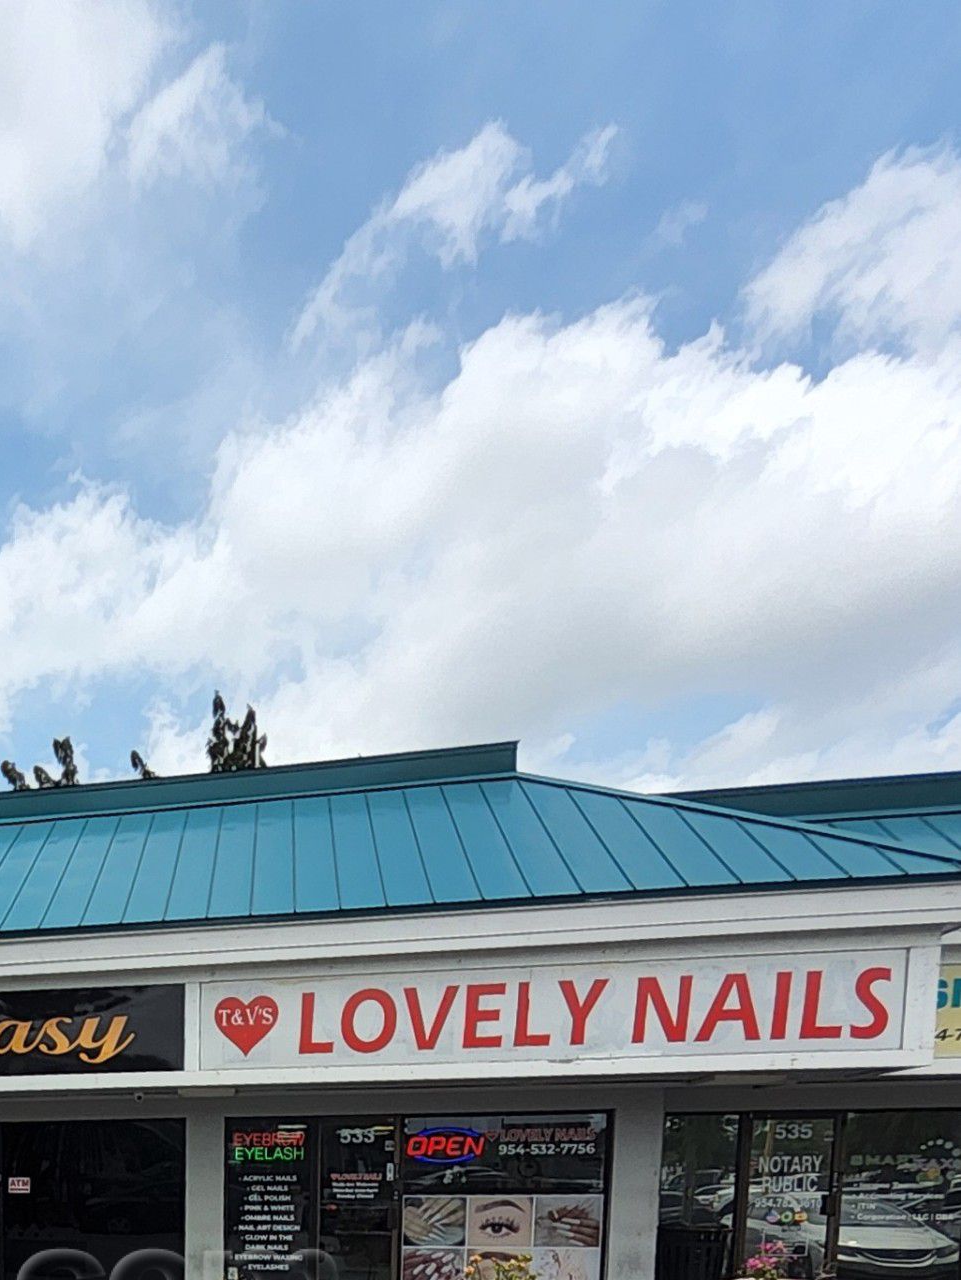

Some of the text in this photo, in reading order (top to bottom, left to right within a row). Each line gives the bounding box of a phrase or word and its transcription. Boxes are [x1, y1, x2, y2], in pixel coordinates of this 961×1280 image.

[218, 1004, 275, 1027] T&V'S
[298, 967, 892, 1055] LOVELY NAILS
[233, 1131, 305, 1146] EYEBROW
[339, 1128, 376, 1143] 533
[499, 1129, 553, 1142] LOVELY
[775, 1123, 813, 1139] 535
[235, 1147, 305, 1160] EYELASH
[406, 1136, 485, 1157] OPEN
[498, 1143, 595, 1156] 954-532-7756
[758, 1155, 823, 1173] NOTARY
[10, 1179, 30, 1187] ATM
[761, 1175, 818, 1193] PUBLIC
